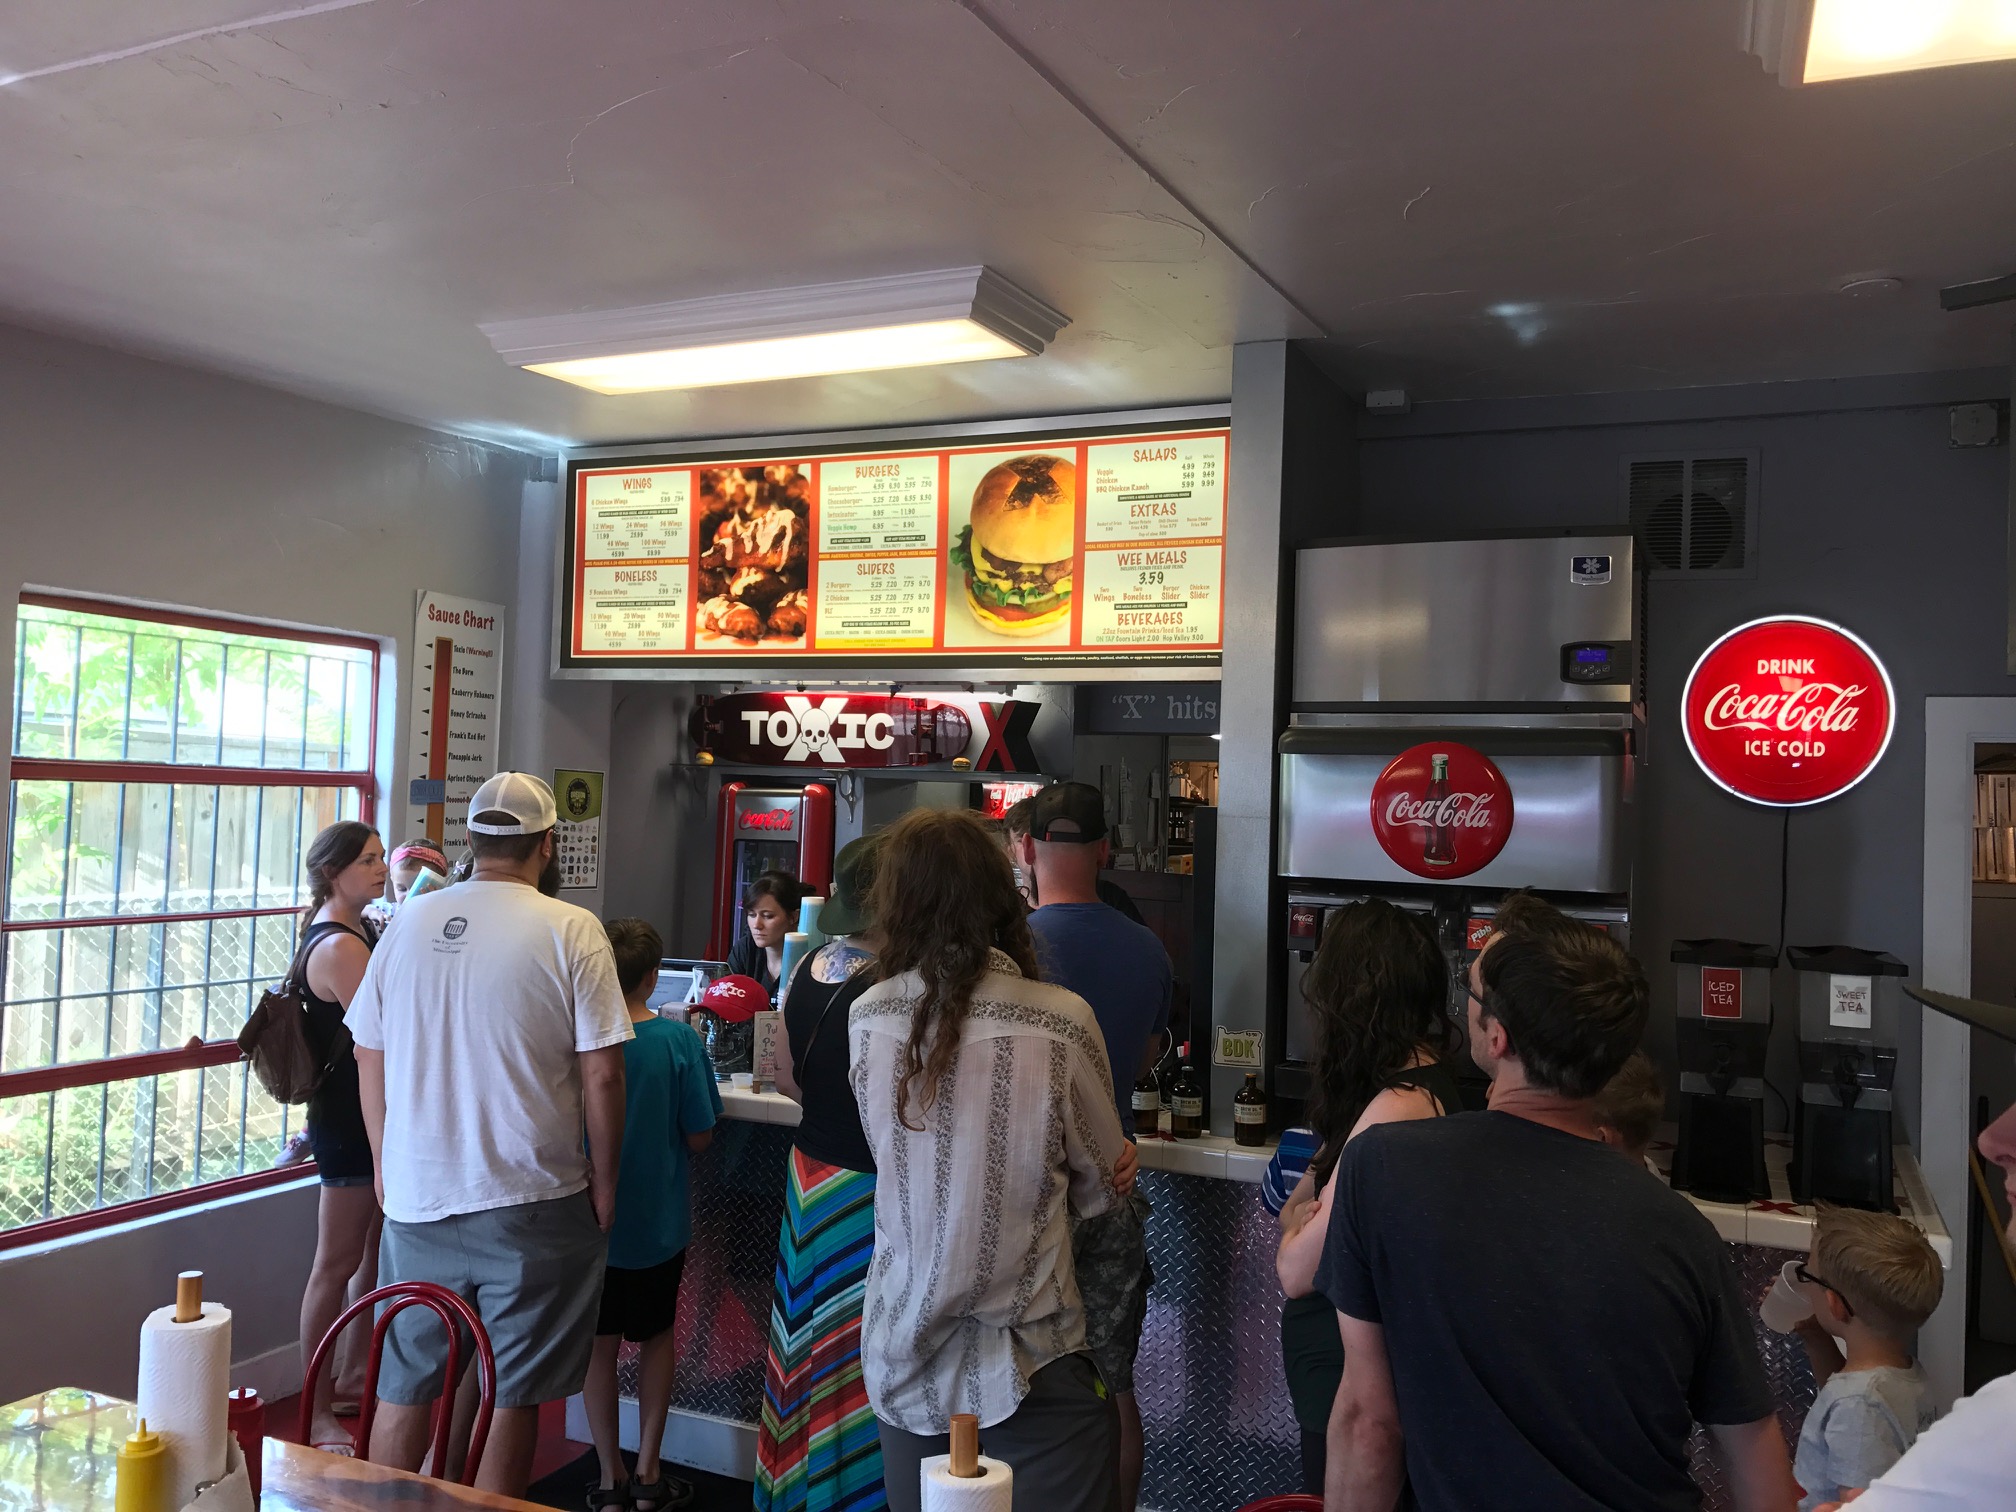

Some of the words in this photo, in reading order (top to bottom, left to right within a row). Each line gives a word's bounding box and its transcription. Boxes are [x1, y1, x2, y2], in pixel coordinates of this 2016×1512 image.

[1133, 447, 1177, 462] SALADS
[855, 464, 900, 479] BURGERS
[1096, 468, 1114, 476] Veggie
[622, 478, 652, 490] WINGS
[1131, 483, 1150, 491] Ranch
[1130, 502, 1177, 517] EXTRAS
[668, 520, 682, 528] Wings
[1117, 552, 1142, 566] WEE
[1146, 550, 1187, 565] MEALS
[857, 563, 895, 576] SLIDERS
[614, 570, 658, 583] BONELESS
[1138, 571, 1164, 585] 3.59
[1094, 594, 1115, 602] Wings
[1123, 592, 1152, 601] Boneless
[1161, 592, 1181, 600] Slider
[1190, 591, 1210, 599] Slider
[428, 603, 460, 625] Sauce
[463, 610, 494, 631] Chart
[1117, 611, 1183, 626] BEVERAGES
[1176, 626, 1184, 634] Tea
[1174, 634, 1190, 642] Valley
[453, 666, 461, 674] The
[462, 667, 474, 676] Burn
[1757, 659, 1816, 674] DRINK
[1167, 694, 1217, 720] hits
[1704, 682, 1868, 732] Coca-Cola
[450, 709, 465, 719] Honey
[466, 710, 486, 720] Sriracha
[449, 730, 466, 739] Frank's
[467, 732, 477, 740] Red
[741, 696, 895, 762] TOXIC
[1744, 741, 1770, 756] ICE
[1777, 741, 1826, 757] COLD
[448, 752, 470, 762] Pineapple
[471, 753, 482, 761] Jerk
[447, 774, 465, 782] Apricot
[1386, 792, 1494, 828] Coca-Cola
[445, 817, 458, 826] Spicy
[738, 808, 796, 832] Coca-Cola
[1470, 925, 1492, 942] Pibb
[706, 982, 747, 998] TOXIC
[1708, 981, 1735, 992] ICED
[1710, 994, 1733, 1005] TEA
[1836, 990, 1867, 1000] SWEET
[1839, 1001, 1863, 1012] TEA
[1222, 1038, 1255, 1058] BDK
